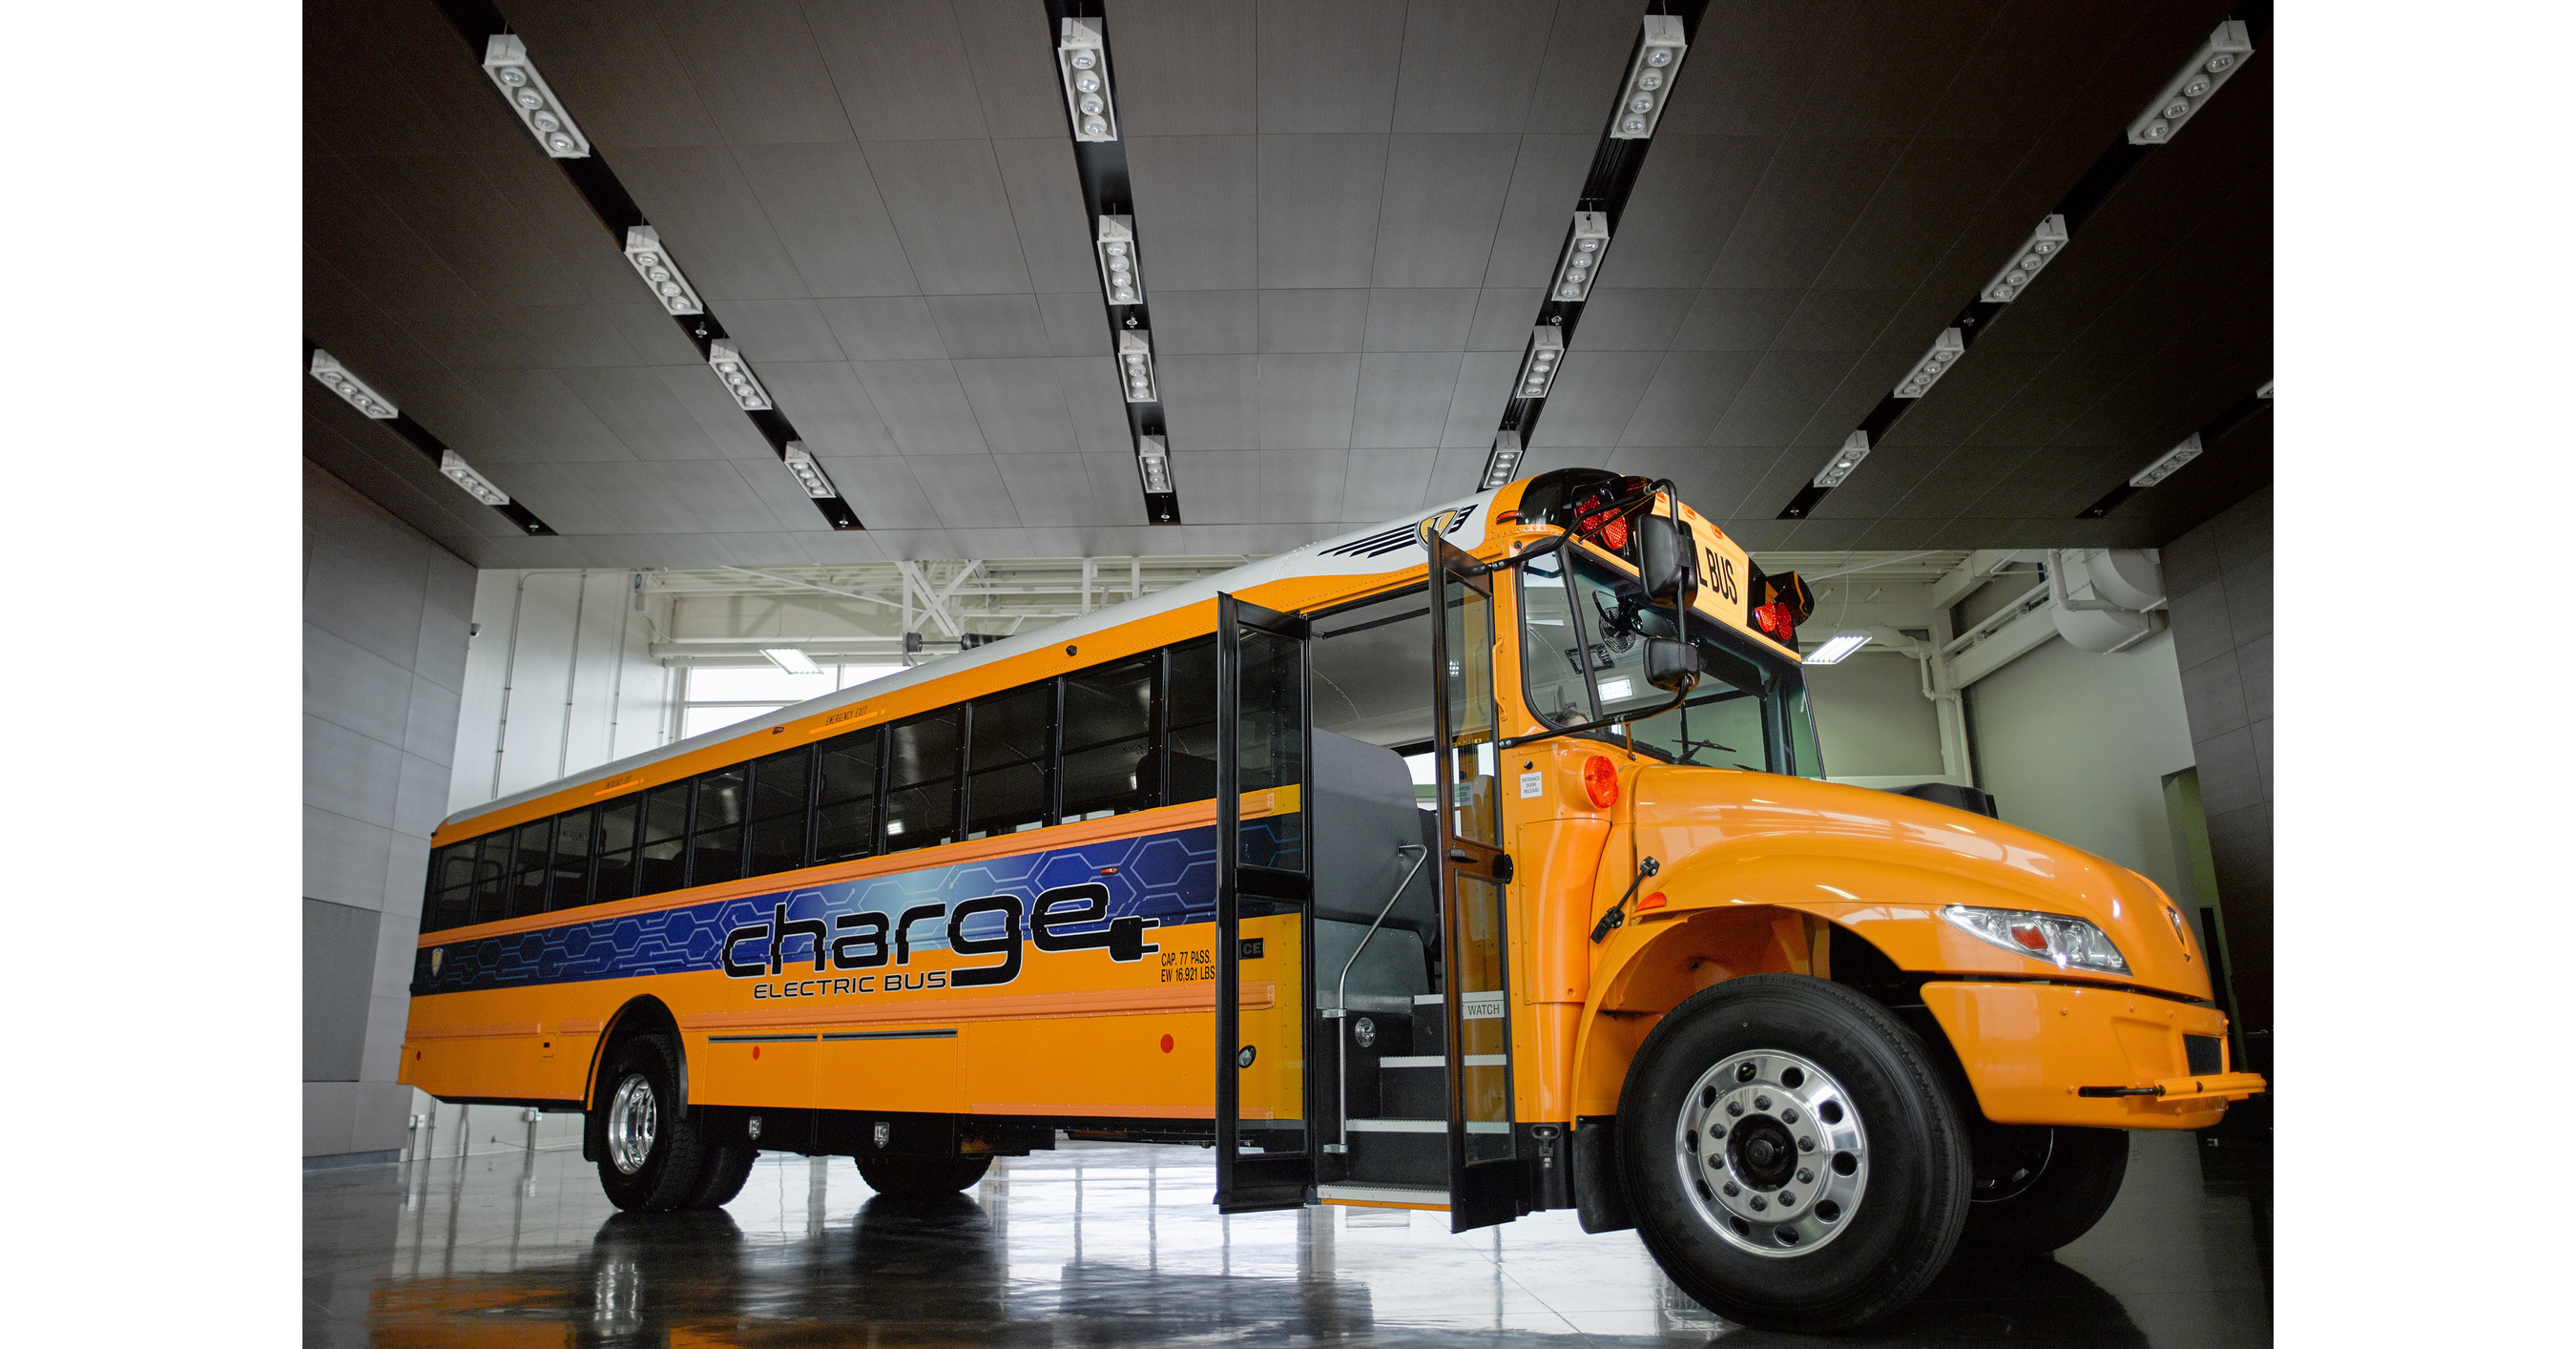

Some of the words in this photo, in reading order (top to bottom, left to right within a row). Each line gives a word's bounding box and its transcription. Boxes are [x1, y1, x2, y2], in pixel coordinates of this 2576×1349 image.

[1705, 546, 1737, 605] BUS
[826, 710, 854, 725] EMERGENCY
[721, 882, 1111, 988] charge
[1161, 952, 1177, 966] CAP.
[1179, 951, 1189, 965] 77
[1191, 949, 1212, 965] PASS.
[1161, 968, 1173, 983] EW
[1175, 966, 1198, 984] 16,921
[1200, 965, 1215, 980] LBS
[754, 976, 875, 1000] ELECTRIC
[883, 970, 947, 993] BUS
[1467, 1004, 1500, 1016] WATCH
